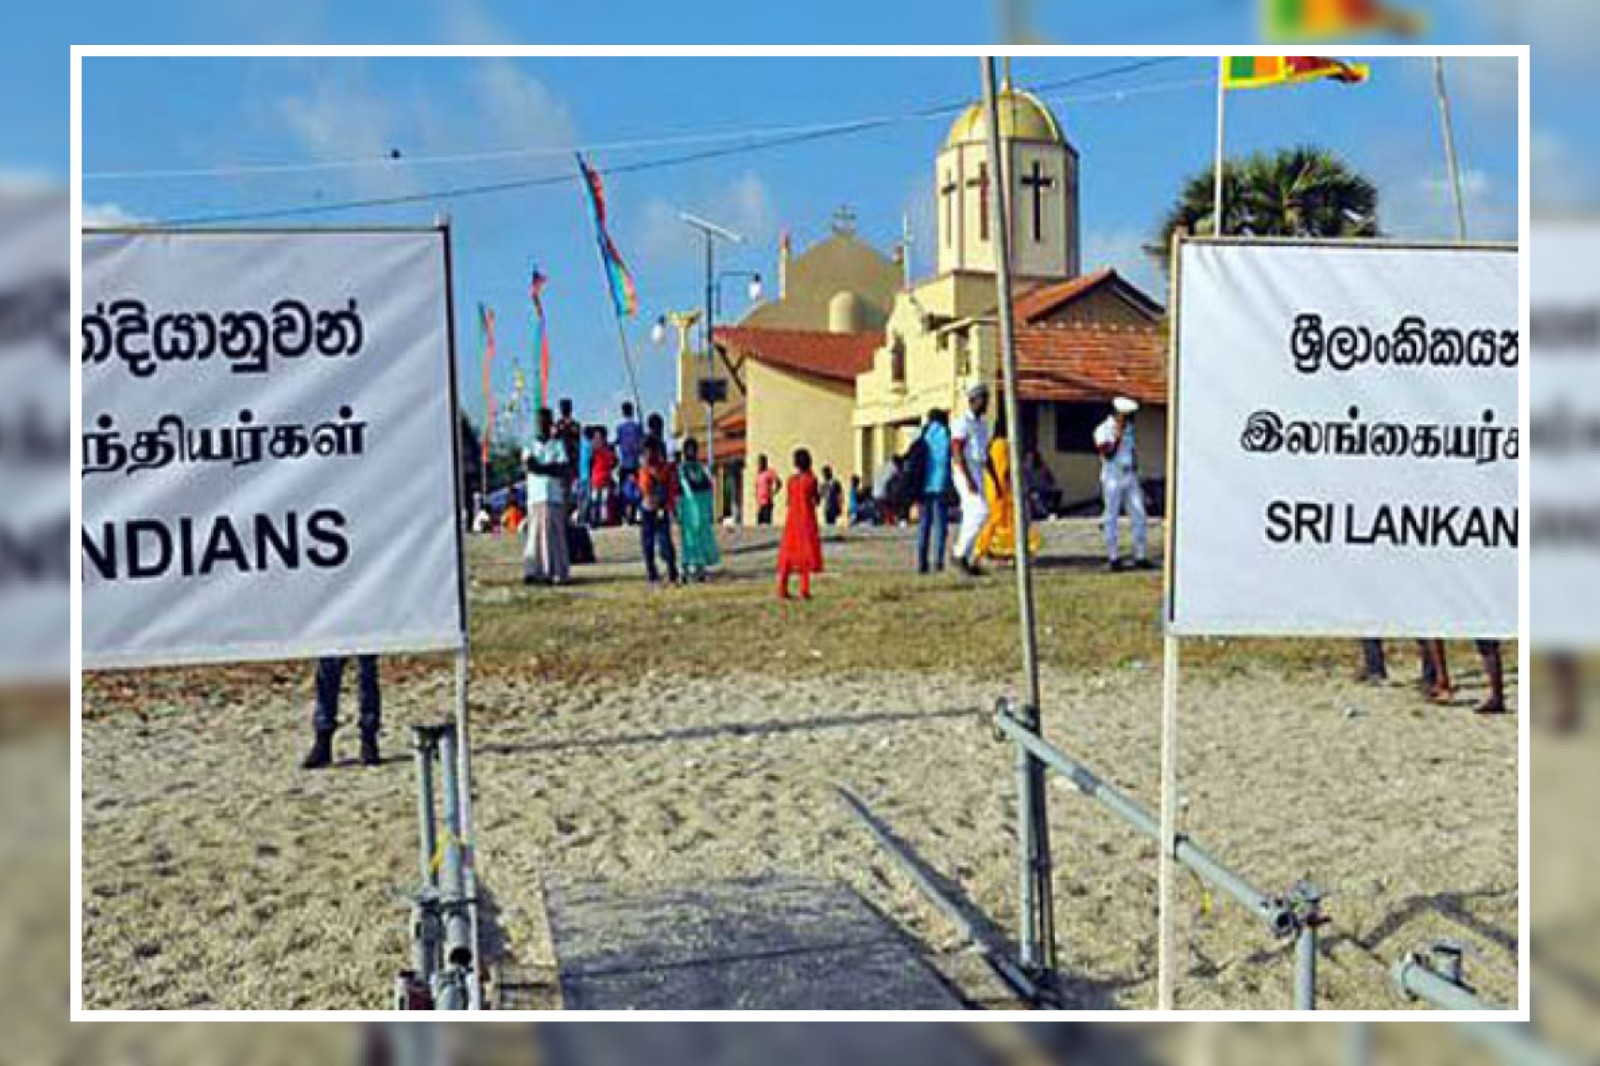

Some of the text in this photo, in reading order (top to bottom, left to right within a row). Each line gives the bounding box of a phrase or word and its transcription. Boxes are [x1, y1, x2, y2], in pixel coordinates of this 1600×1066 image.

[82, 509, 348, 581] NDIANS
[1265, 501, 1334, 543] SRI
[1345, 503, 1518, 547] LANKAN
